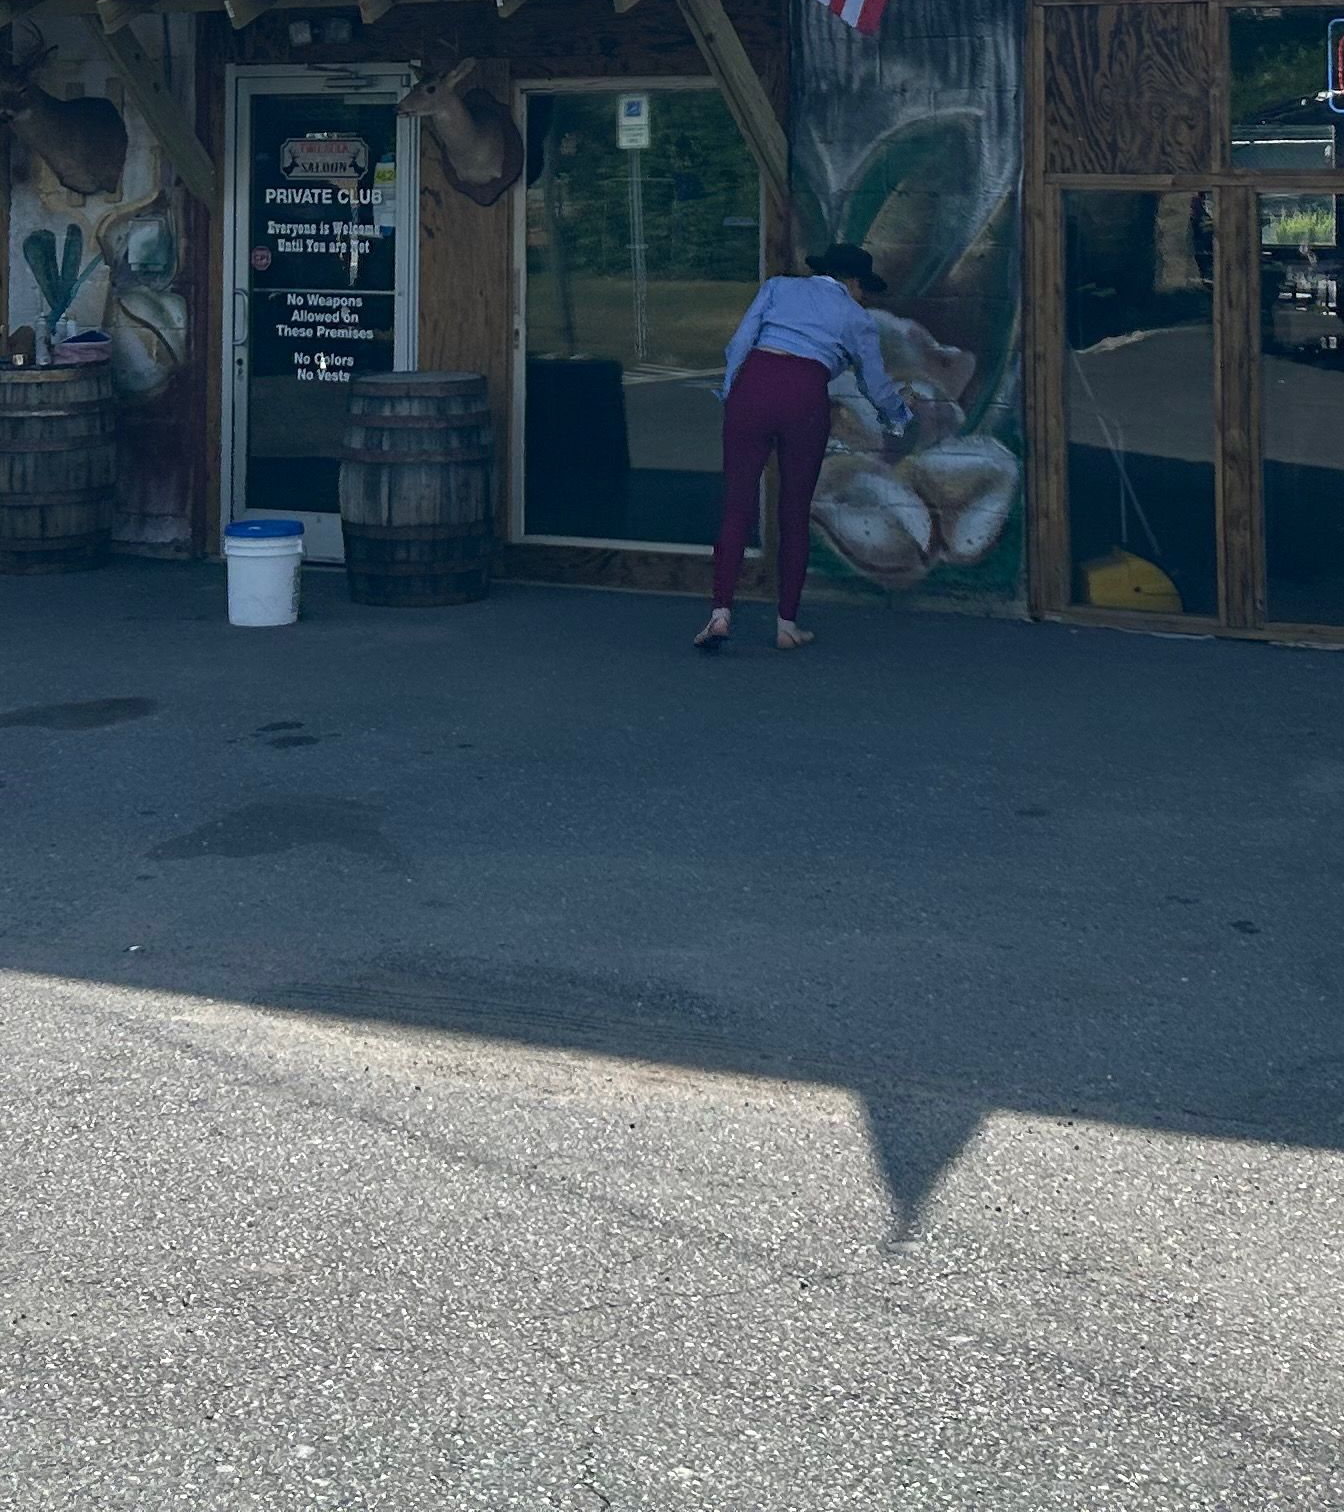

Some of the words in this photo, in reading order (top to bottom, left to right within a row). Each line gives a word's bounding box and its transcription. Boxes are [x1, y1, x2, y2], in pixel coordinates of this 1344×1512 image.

[301, 162, 347, 173] SALOON
[265, 189, 332, 204] PRIVATE
[337, 188, 382, 204] CLUB
[268, 221, 316, 236] Everyone
[320, 222, 329, 234] is
[332, 222, 381, 235] Welcome
[278, 239, 303, 252] Until
[306, 239, 326, 252] You
[329, 242, 346, 253] are
[350, 239, 370, 254] Not
[287, 293, 303, 305] No
[307, 294, 363, 308] Weapons
[291, 310, 340, 322] Allowed
[343, 314, 359, 323] on
[276, 324, 313, 337] These
[317, 326, 373, 339] Premises
[294, 352, 310, 364] No
[314, 352, 354, 366] Colors
[297, 368, 313, 380] No
[317, 369, 351, 382] Vests
